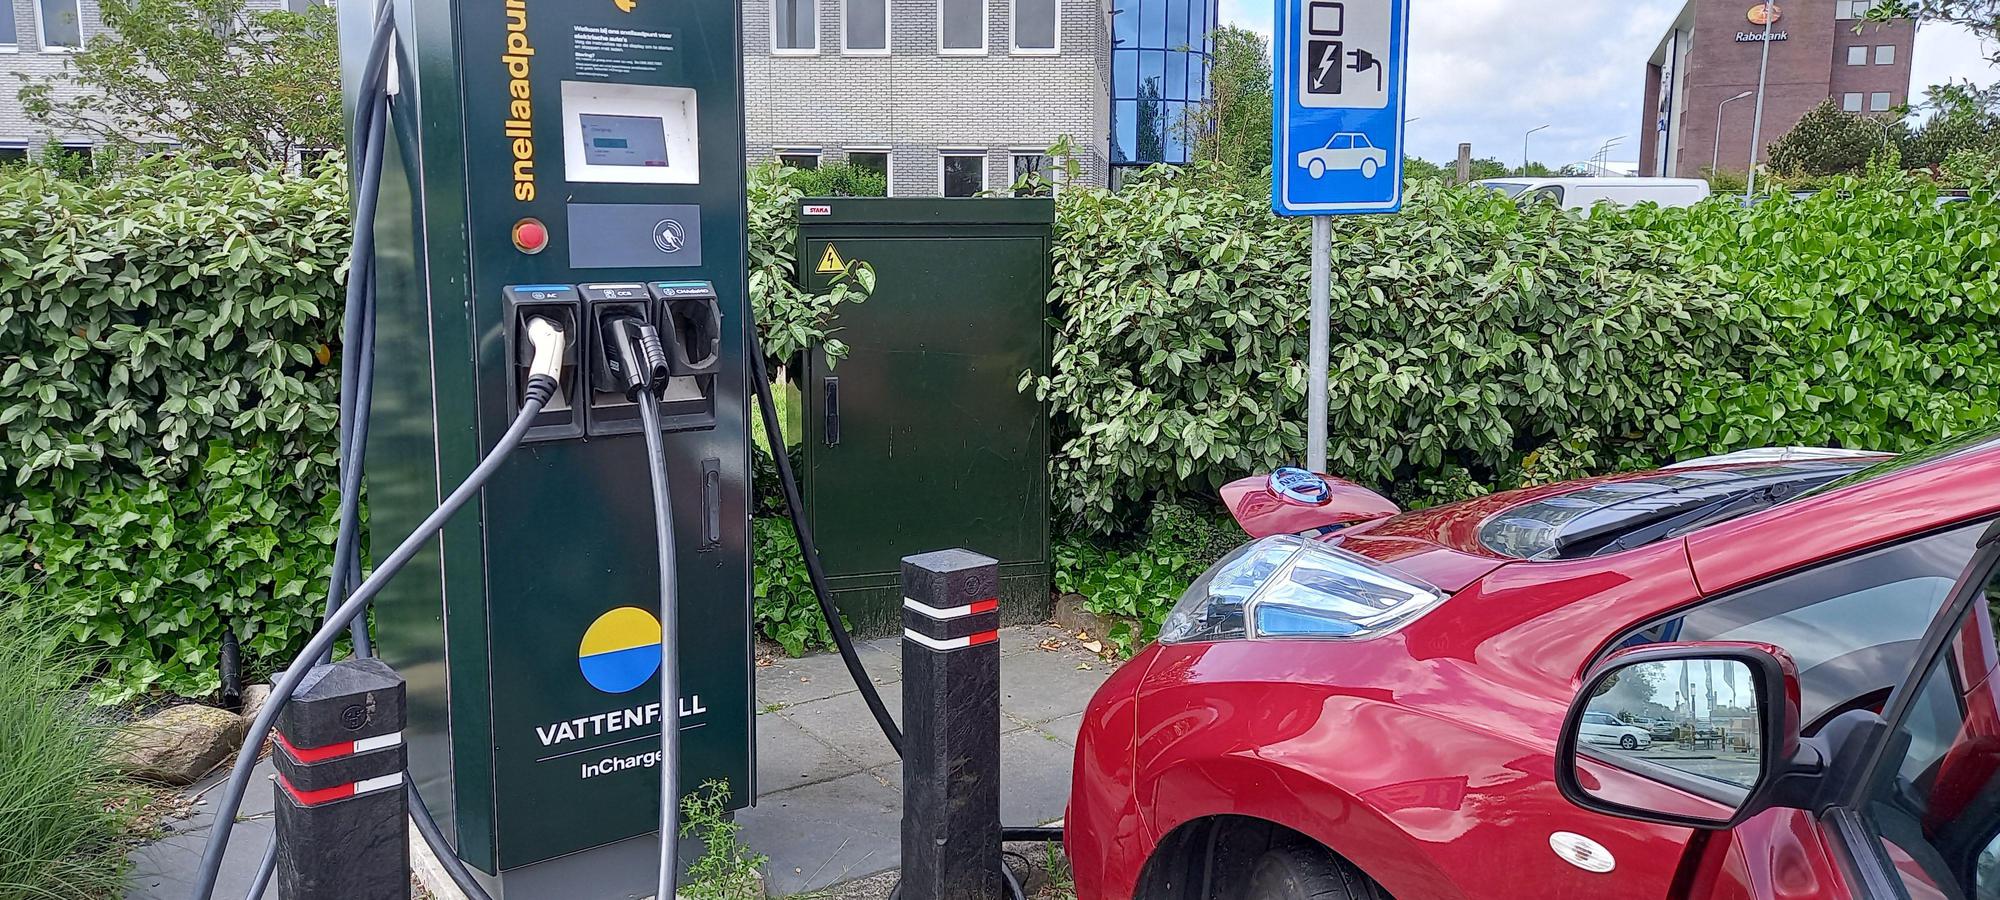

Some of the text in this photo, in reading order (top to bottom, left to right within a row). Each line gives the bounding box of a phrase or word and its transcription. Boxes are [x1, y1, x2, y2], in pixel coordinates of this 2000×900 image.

[1735, 30, 1788, 42] Rabobank
[535, 695, 707, 746] VATTENFLL
[581, 750, 662, 779] InCharge
